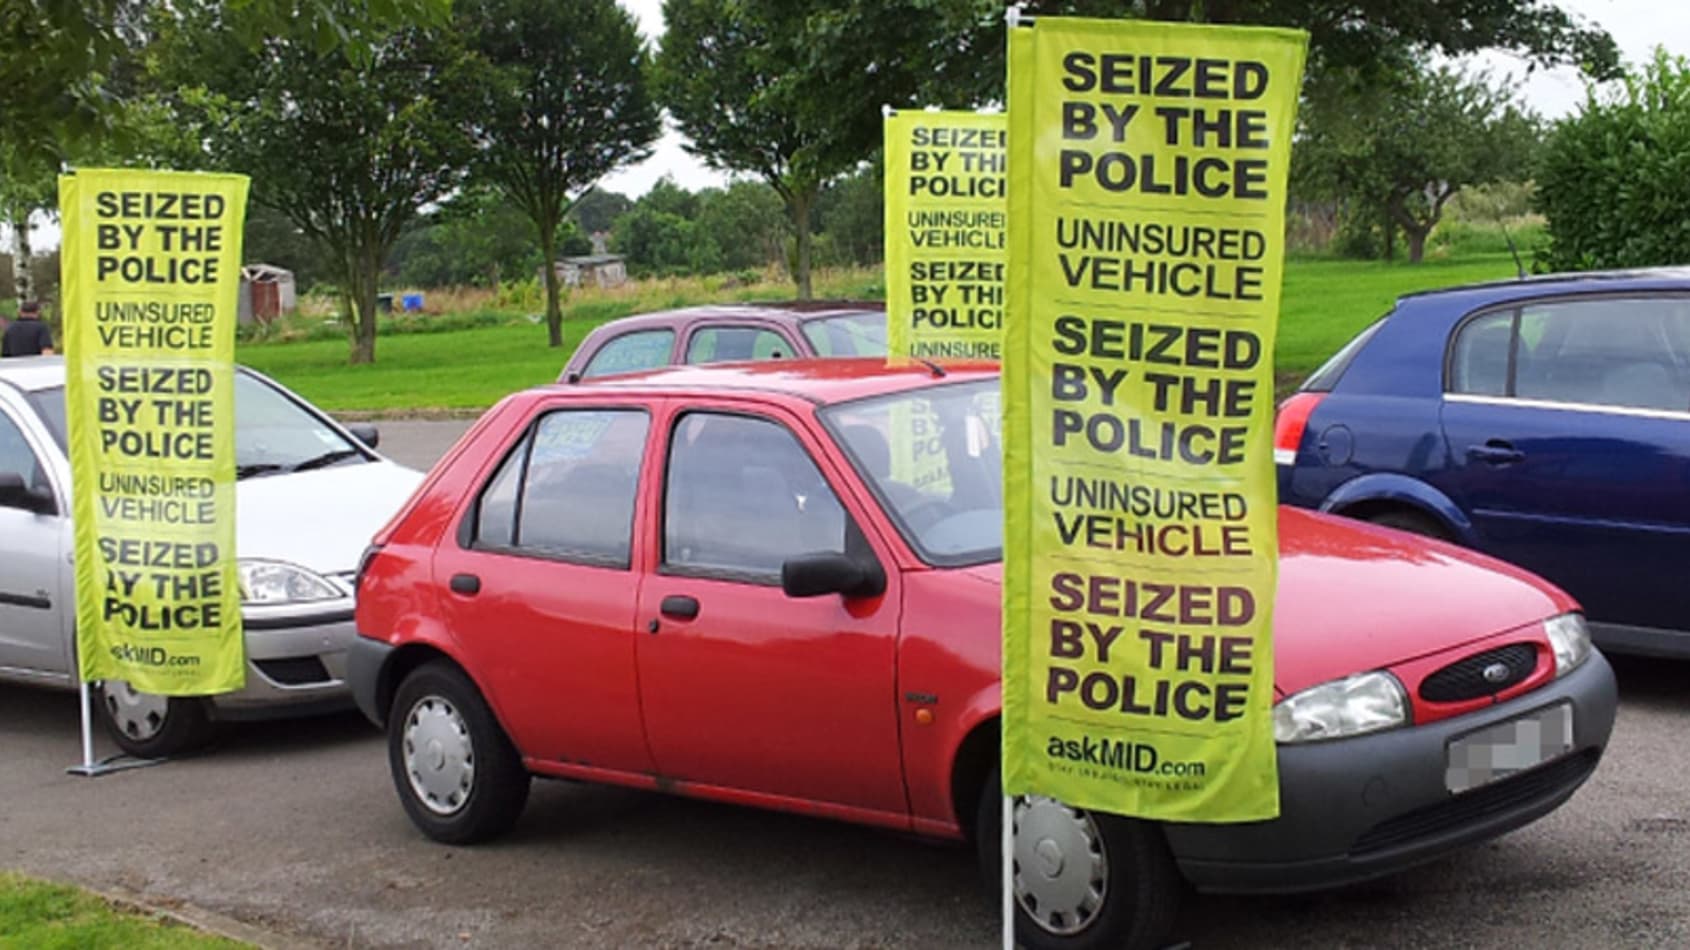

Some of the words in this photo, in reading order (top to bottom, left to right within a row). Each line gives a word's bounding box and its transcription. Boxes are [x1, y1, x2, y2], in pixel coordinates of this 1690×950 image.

[1062, 52, 1269, 100] SEIZED
[911, 127, 1006, 148] SEIZE
[1062, 102, 1140, 142] BY
[1155, 106, 1269, 149] THE
[911, 152, 950, 171] BY
[1060, 149, 1268, 199] POLICE
[97, 192, 225, 219] SEIZED
[908, 211, 1004, 229] UNINSURE
[98, 225, 144, 250] BY
[155, 226, 222, 251] THE
[1057, 217, 1266, 260] UNINSURED
[98, 256, 219, 284] POLICE
[1058, 254, 1263, 300] VEHICLE
[911, 285, 948, 304] BY
[957, 285, 1003, 305] TH
[96, 302, 215, 323] UNINSURED
[912, 309, 1002, 329] POLIC
[97, 326, 213, 348] VEHICLE
[910, 342, 1000, 359] UNINSURE
[1052, 316, 1261, 370] SEIZED
[98, 366, 212, 393] SEIZED
[1052, 363, 1128, 406] BY
[1143, 372, 1257, 417] THE
[99, 399, 143, 424] BY
[151, 401, 213, 427] THE
[102, 430, 214, 459] POLICE
[1052, 409, 1248, 465] POLICE
[99, 472, 215, 499] UNINSURED
[1051, 475, 1247, 521] UNINSURED
[101, 496, 216, 524] VEHICLE
[1053, 512, 1253, 556] VEHICLE
[98, 537, 218, 569] SEIZED
[150, 572, 222, 601] THE
[1049, 572, 1256, 626] SEIZED
[104, 598, 222, 630] POLICE
[1050, 619, 1124, 663] BY
[1139, 629, 1254, 674] THE
[1046, 667, 1250, 722] POLICE
[1047, 735, 1205, 776] askMID.com
